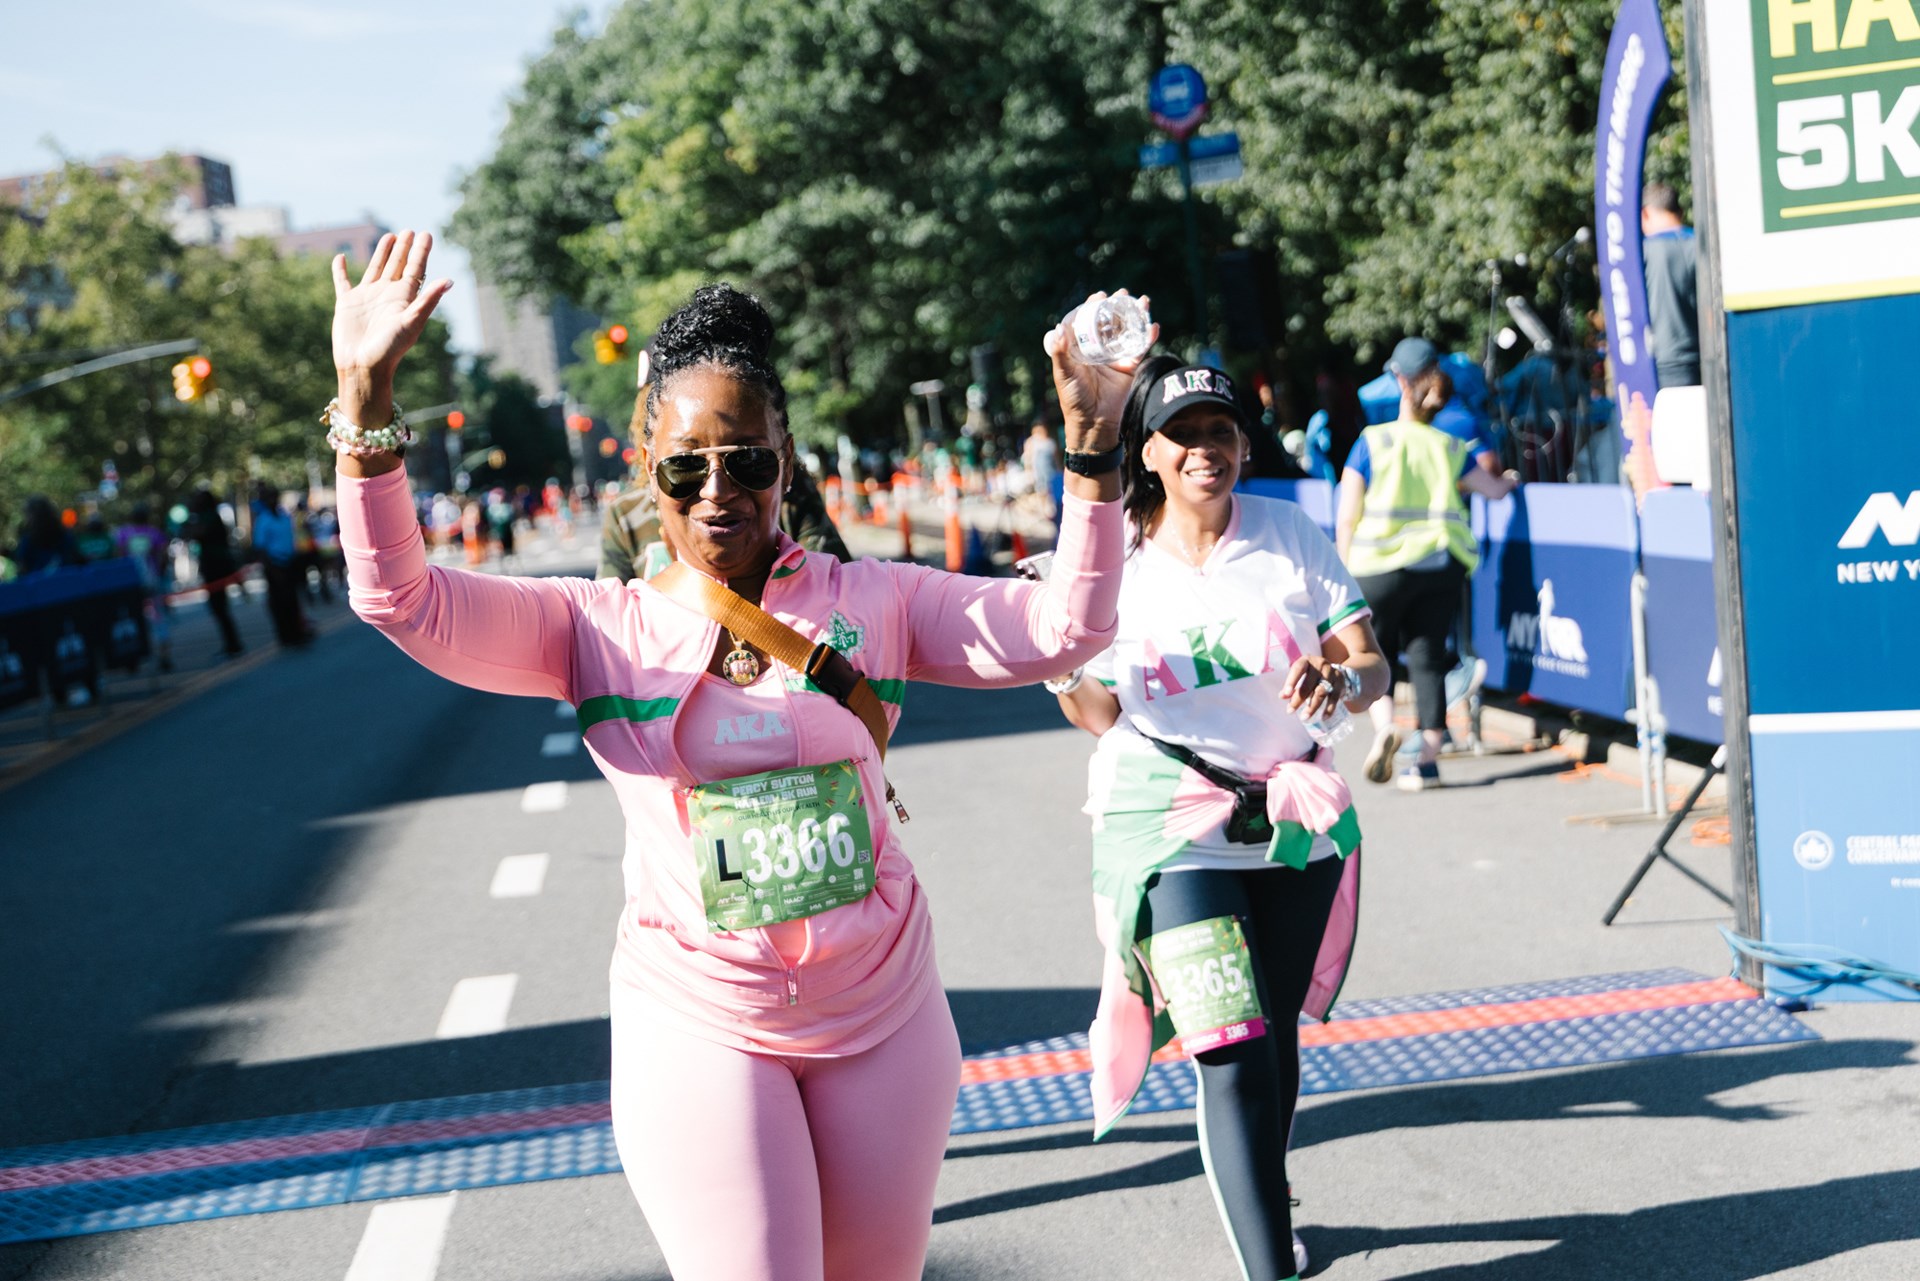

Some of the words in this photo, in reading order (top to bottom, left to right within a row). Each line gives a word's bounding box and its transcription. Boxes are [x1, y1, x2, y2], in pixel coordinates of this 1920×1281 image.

[1776, 85, 1920, 191] 5K
[1837, 560, 1899, 584] NEW
[1903, 559, 1920, 580] Y
[1144, 608, 1303, 701] AKA
[714, 711, 791, 745] AKA
[731, 781, 768, 797] PERCY
[770, 773, 815, 790] SUTTON
[734, 793, 775, 810] HARLEM
[796, 786, 818, 798] RUN
[742, 812, 855, 883] 3366
[1165, 953, 1242, 1008] 3365
